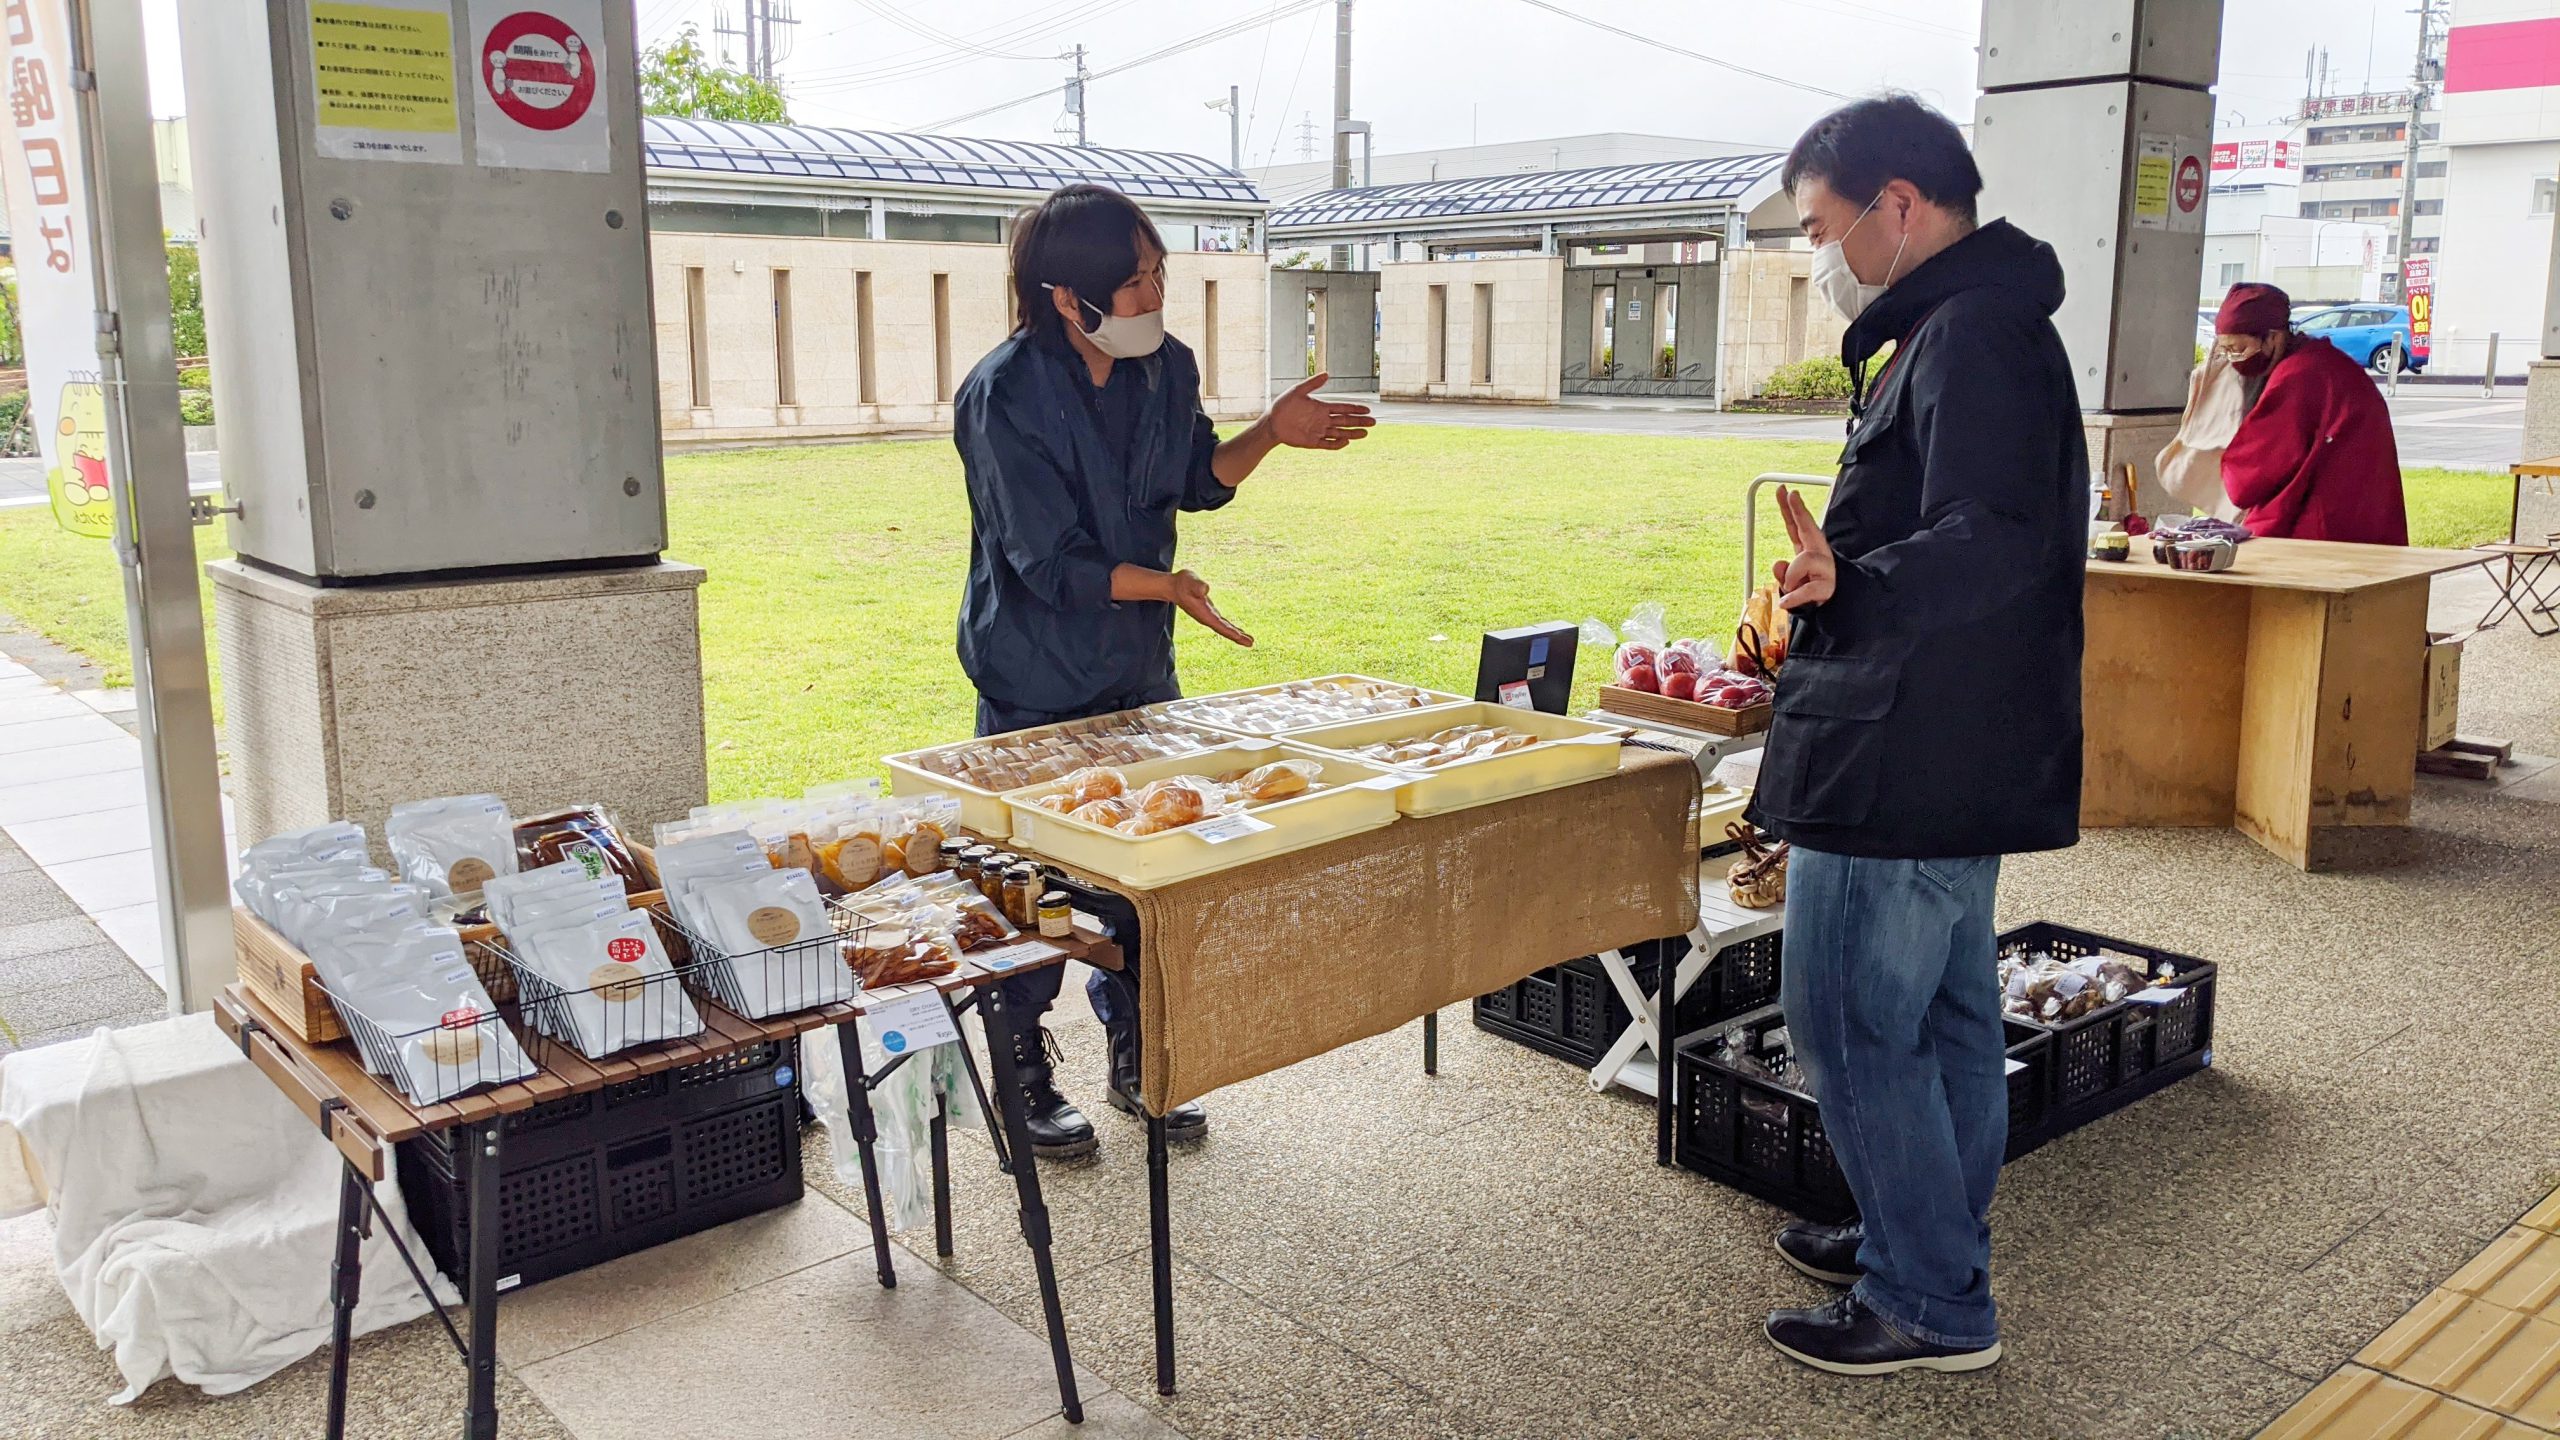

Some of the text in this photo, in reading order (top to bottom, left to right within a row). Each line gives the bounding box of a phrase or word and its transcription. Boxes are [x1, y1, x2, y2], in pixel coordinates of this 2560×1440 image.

[513, 44, 560, 58] 間隔をあけて
